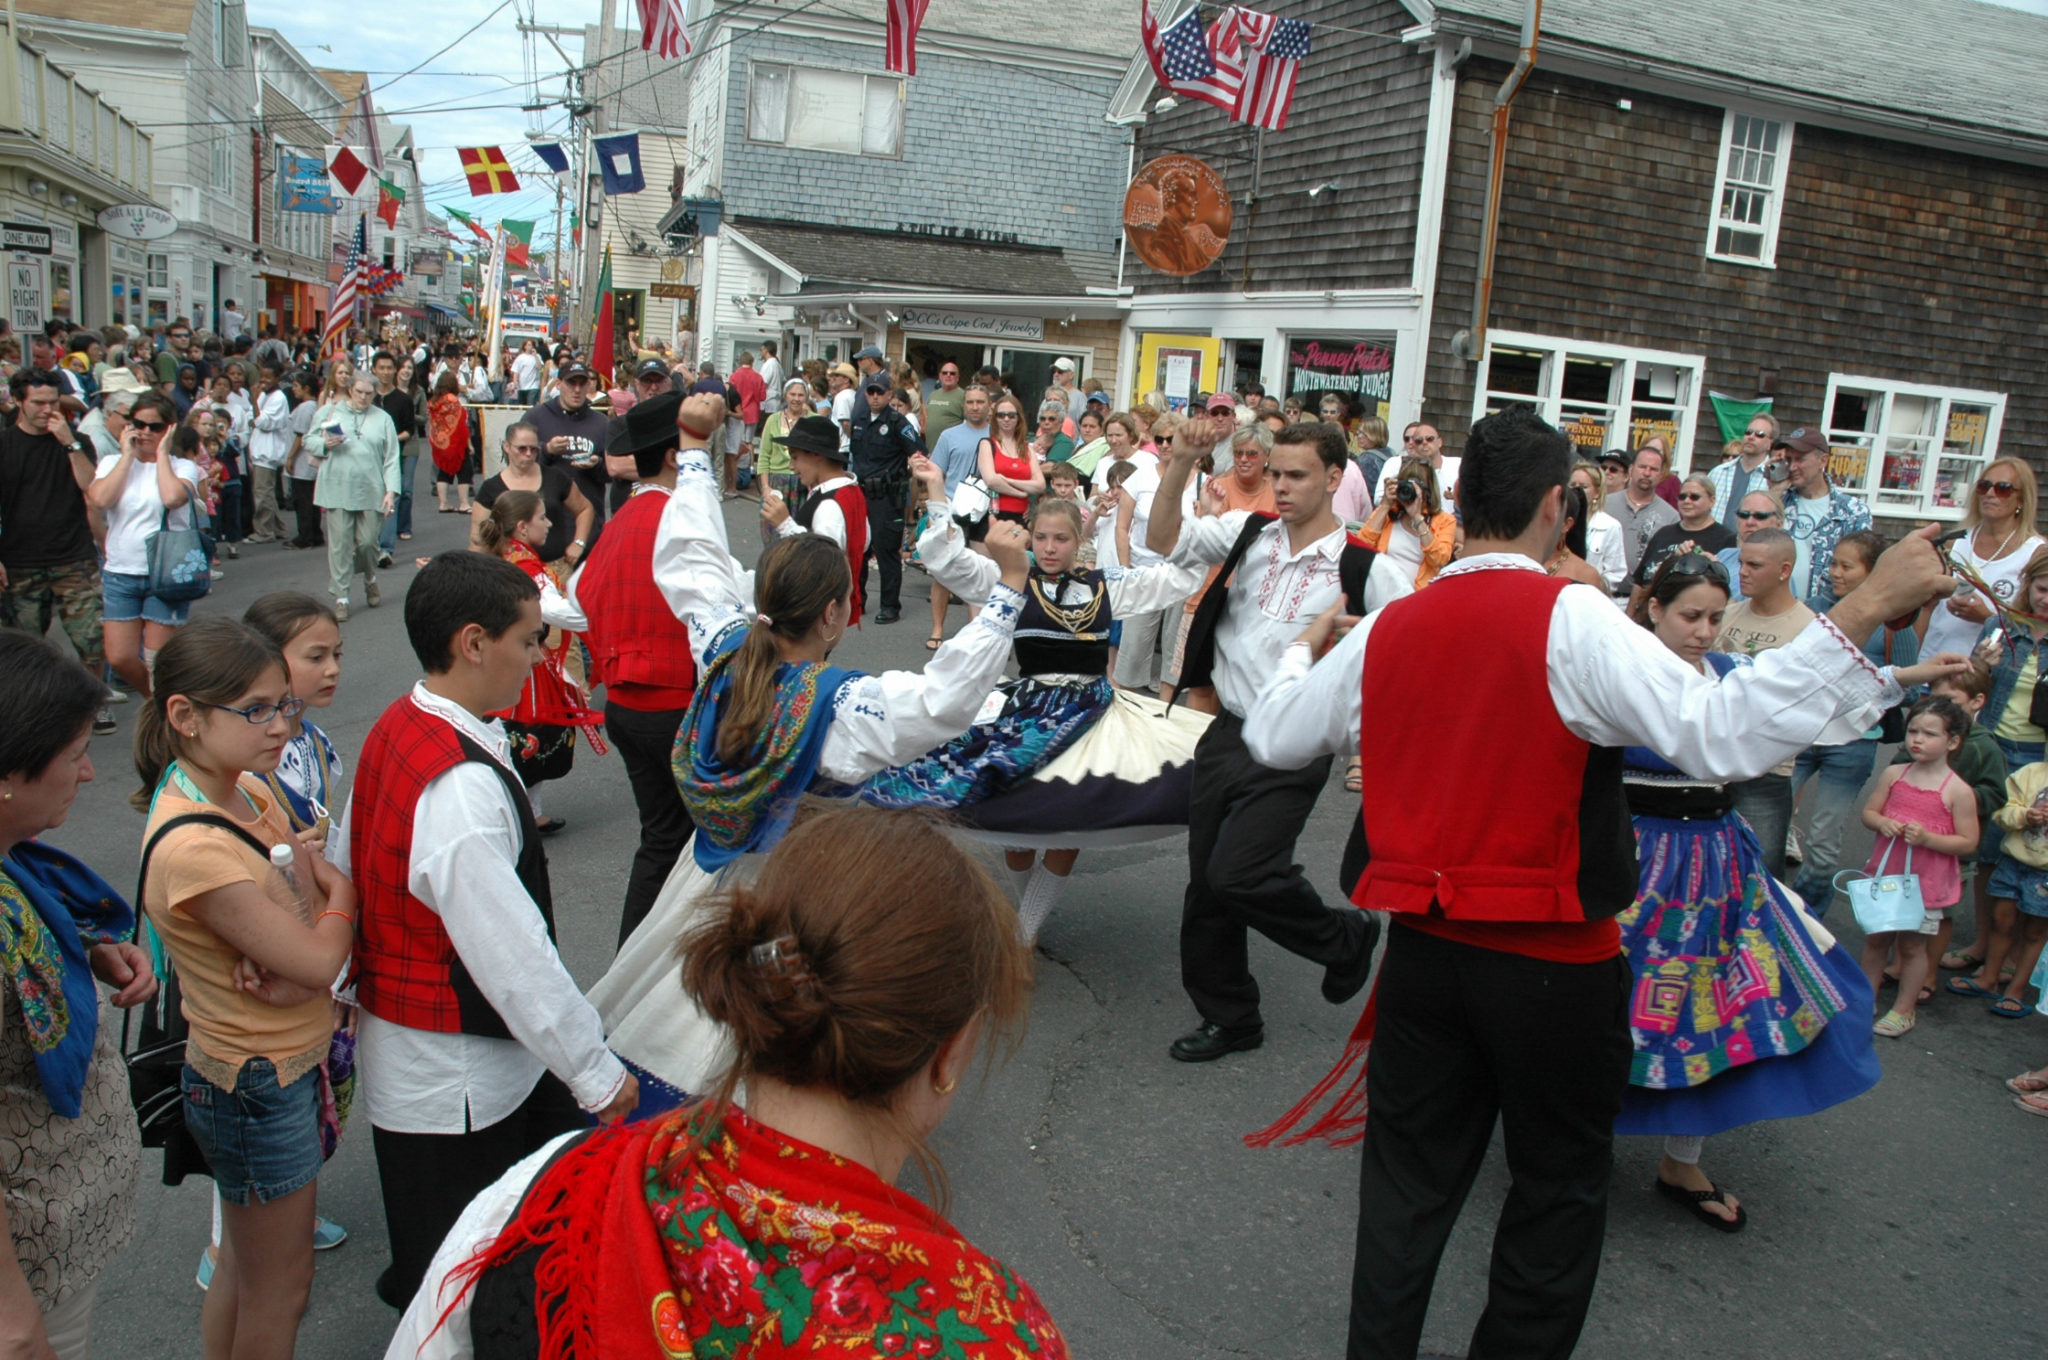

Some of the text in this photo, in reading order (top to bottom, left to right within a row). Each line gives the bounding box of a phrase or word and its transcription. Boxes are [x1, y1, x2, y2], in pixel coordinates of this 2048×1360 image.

[104, 208, 124, 220] Soft
[145, 208, 171, 224] Grape
[4, 232, 46, 246] ONE WAY
[18, 269, 32, 287] NO
[12, 289, 40, 307] RIGHT
[15, 309, 39, 327] TURN
[942, 314, 969, 329] Cape
[972, 319, 996, 329] Cod
[995, 320, 1041, 336] Jewelry
[1291, 341, 1392, 375] The Penney Patch
[1292, 367, 1391, 401] MOUTHWATERING FUDGE
[1564, 423, 1607, 436] PENNEY
[1950, 422, 1986, 445] TAFFY
[1828, 455, 1867, 478] FUDGE
